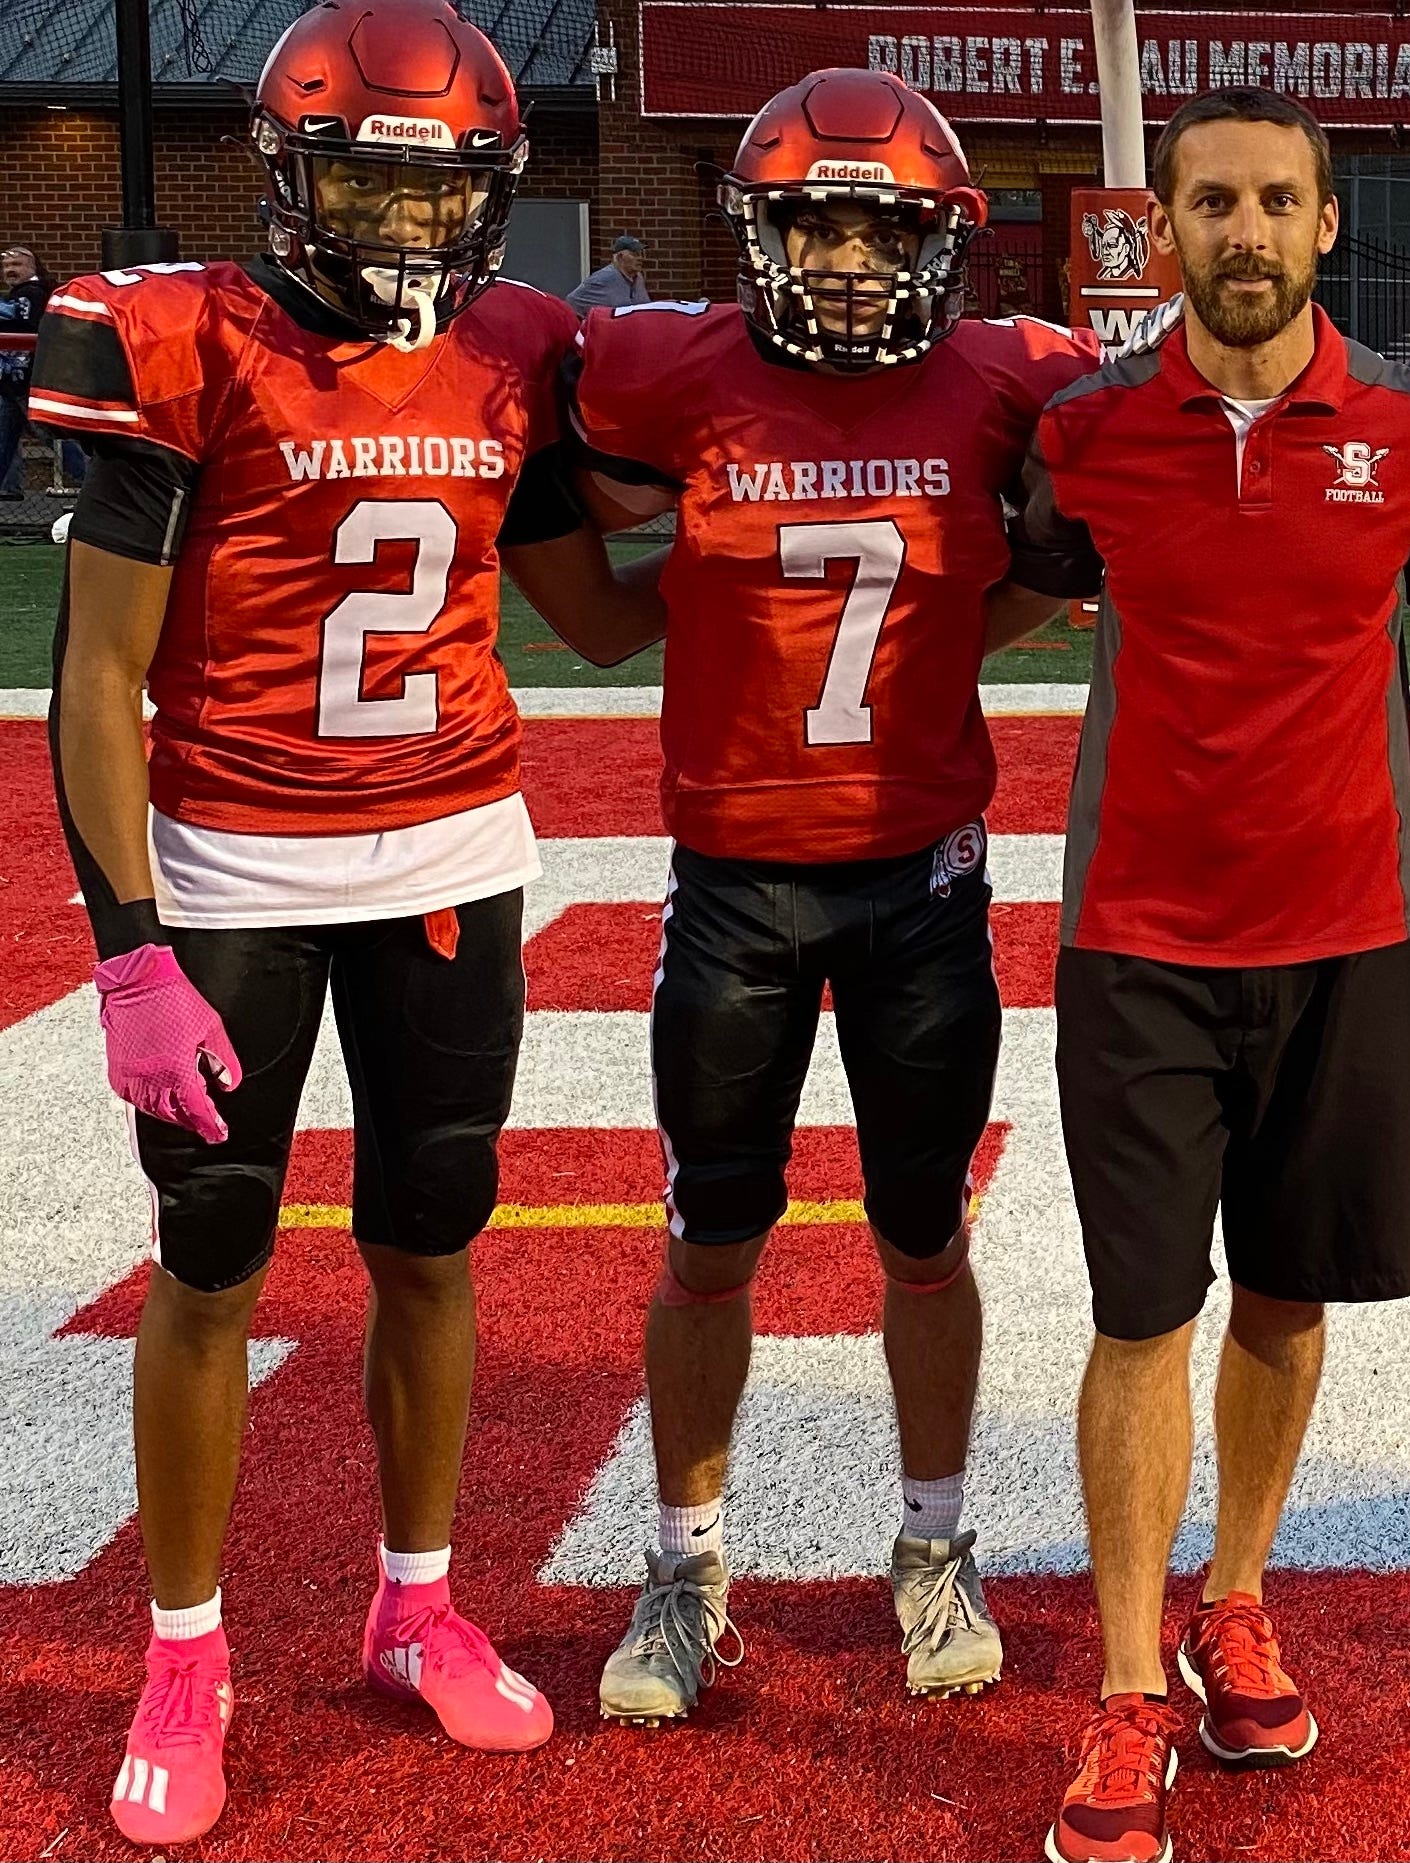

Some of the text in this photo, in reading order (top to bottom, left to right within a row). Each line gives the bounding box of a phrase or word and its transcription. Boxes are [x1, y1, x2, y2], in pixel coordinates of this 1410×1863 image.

[867, 35, 1048, 94] ROBERT
[1140, 39, 1198, 95] AU
[370, 120, 442, 139] Riddell
[817, 165, 884, 181] Riddell
[279, 436, 505, 482] WARRIORS
[727, 458, 950, 501] WARRIORS
[1325, 489, 1384, 503] FOOTBALL
[316, 499, 458, 740] 2
[778, 520, 906, 747] 7
